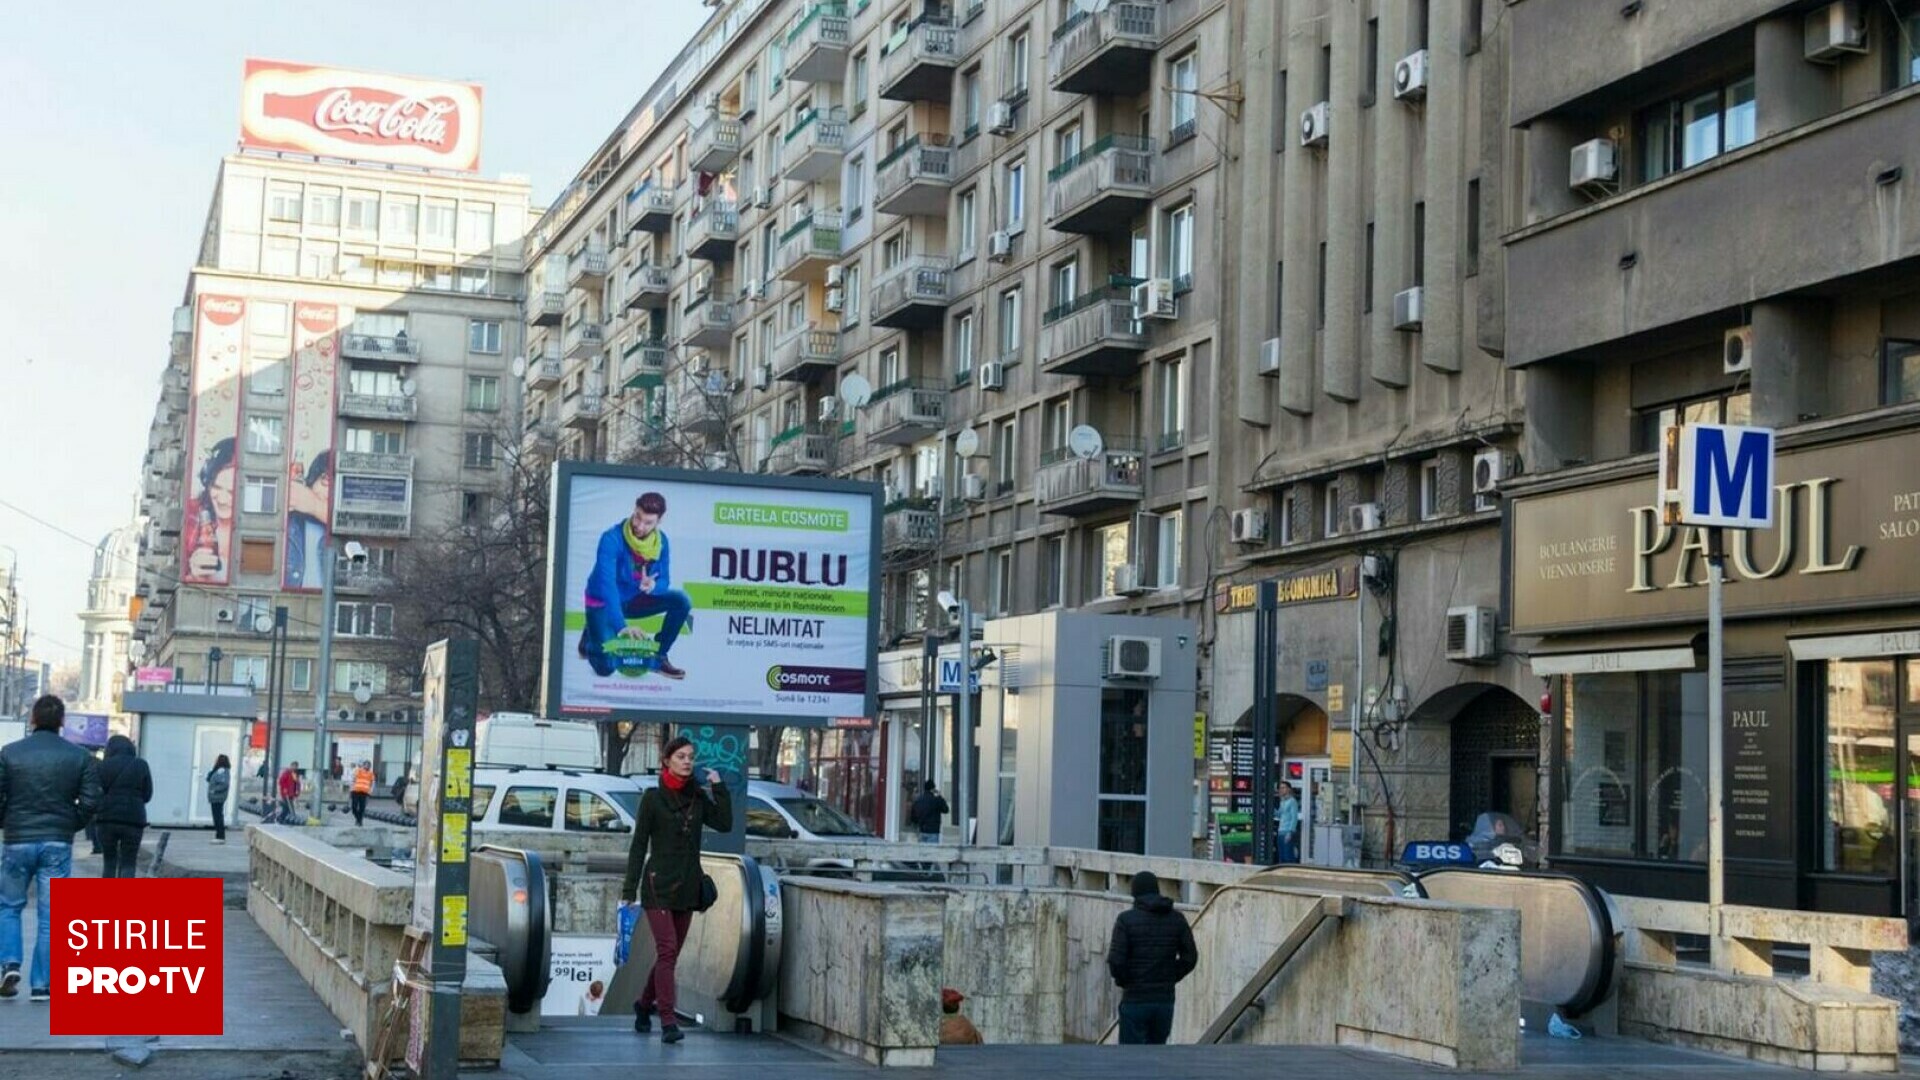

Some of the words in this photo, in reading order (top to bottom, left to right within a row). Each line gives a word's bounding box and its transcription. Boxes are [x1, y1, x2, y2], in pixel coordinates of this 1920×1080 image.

[1693, 427, 1769, 520] M
[719, 506, 778, 523] CARTELA
[781, 510, 845, 527] COSMOTE
[1540, 535, 1617, 559] BOULANGERIE
[711, 546, 847, 587] DUBLU
[1540, 557, 1617, 580] VIENNOISERIE
[728, 615, 825, 638] NELIMITAT
[774, 672, 831, 686] COSMOTE
[943, 661, 961, 683] M
[1733, 710, 1769, 728] PAUL
[1415, 845, 1461, 859] BGS
